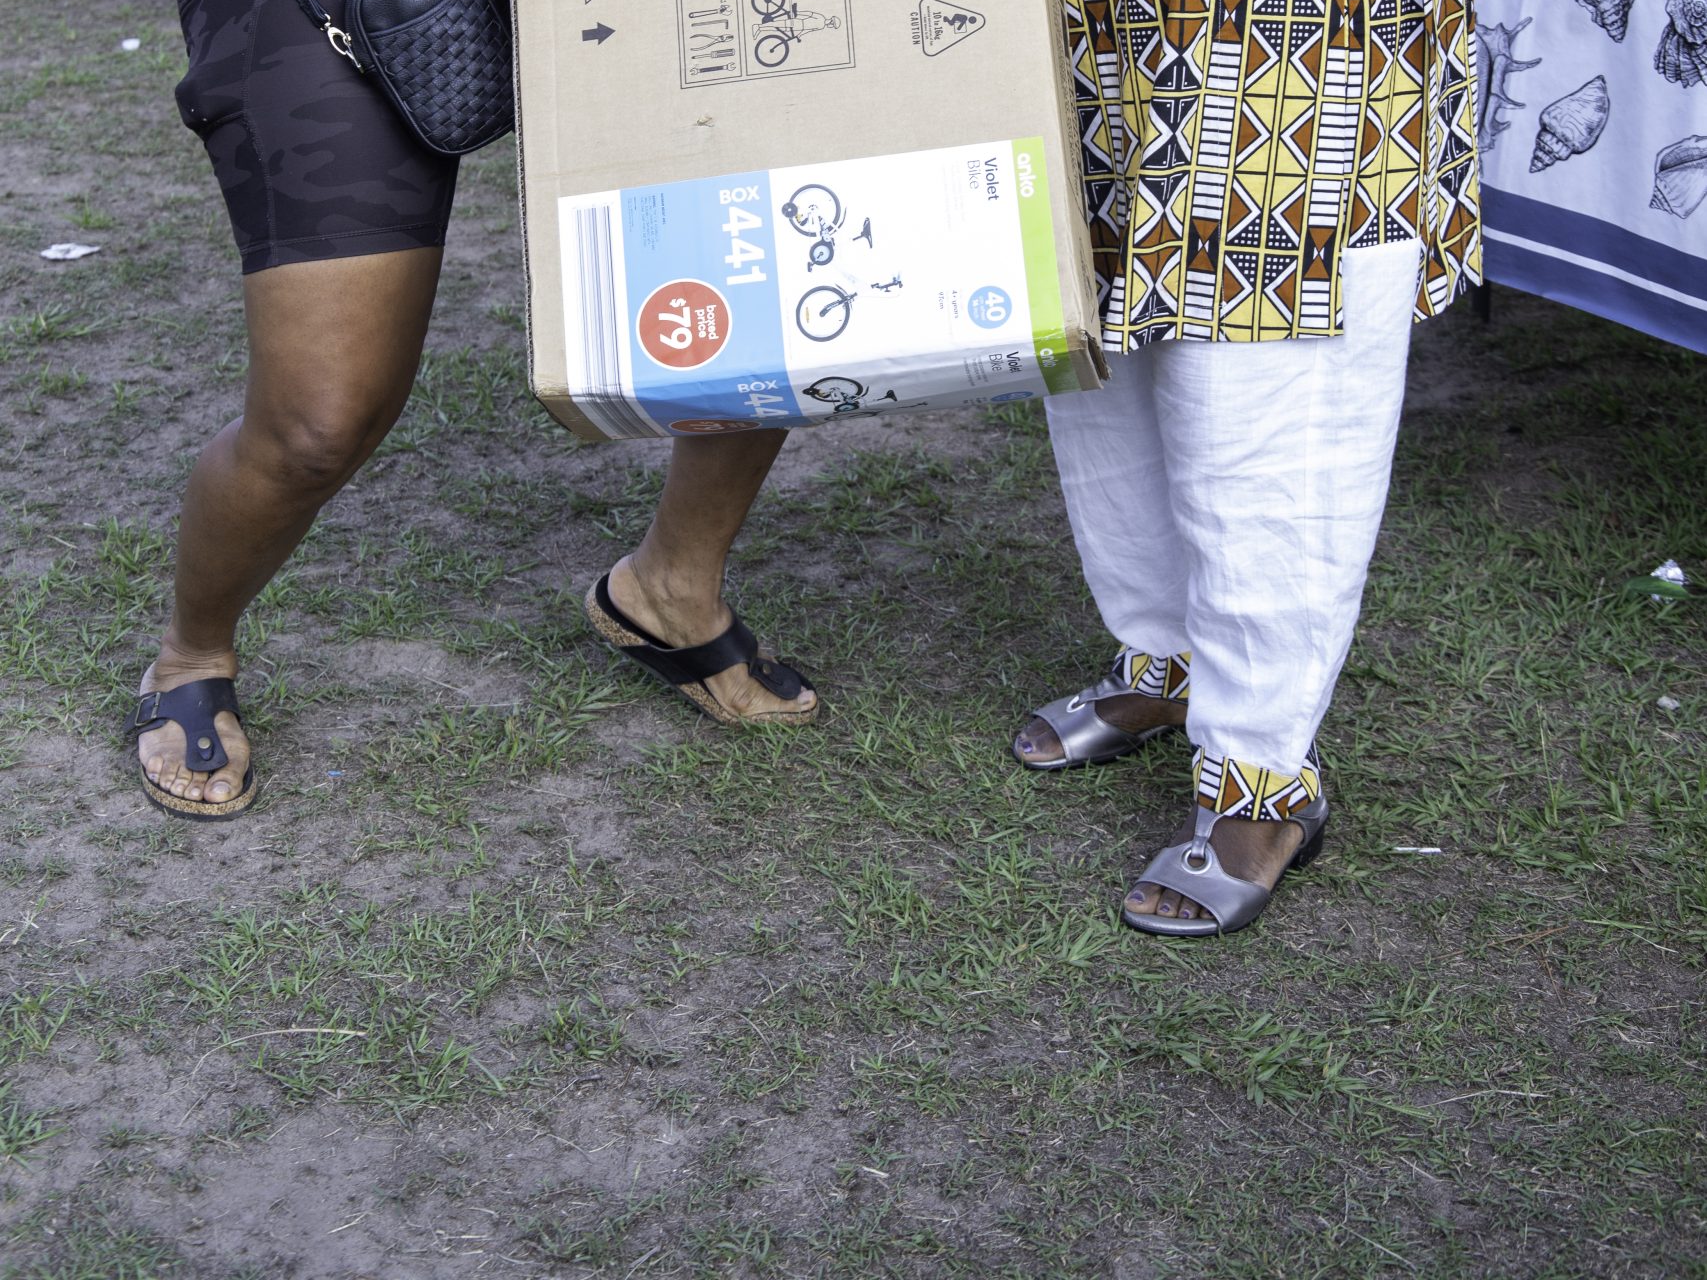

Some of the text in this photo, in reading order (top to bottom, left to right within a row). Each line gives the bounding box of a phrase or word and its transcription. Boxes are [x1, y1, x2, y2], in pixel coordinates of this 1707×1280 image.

[910, 12, 921, 45] CAUTION
[967, 159, 980, 190] Bike
[984, 157, 999, 201] Violet
[1017, 152, 1037, 197] anko
[719, 185, 760, 205] BOX
[721, 206, 767, 286] 441
[706, 304, 719, 340] boxed
[984, 291, 1006, 322] 40
[694, 309, 706, 338] price
[737, 380, 778, 394] BOX
